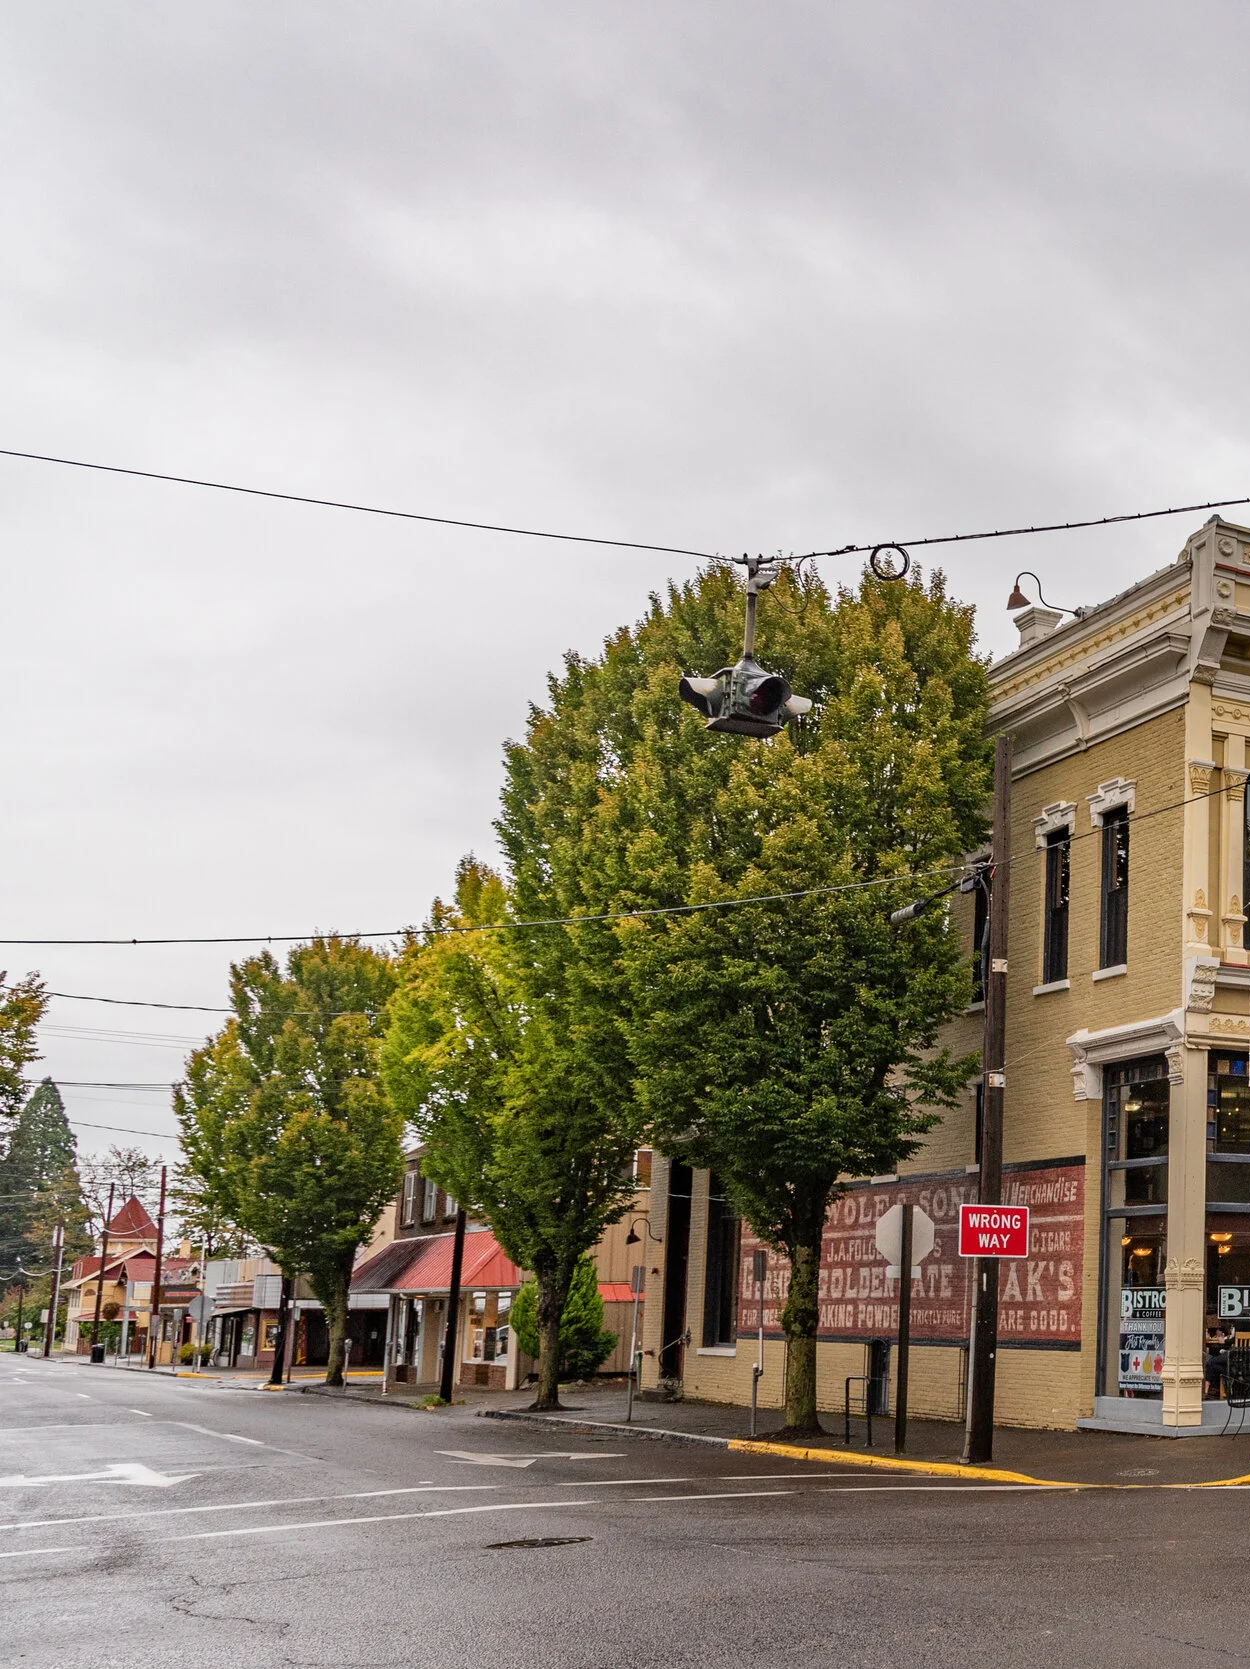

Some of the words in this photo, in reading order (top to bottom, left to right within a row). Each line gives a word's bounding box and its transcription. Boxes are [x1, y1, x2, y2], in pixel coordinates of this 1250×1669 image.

[968, 1213, 1021, 1230] WRONG
[978, 1234, 1011, 1249] WAY
[1121, 1289, 1166, 1318] BISTRO
[820, 1305, 853, 1329] AKING
[858, 1304, 899, 1329] POWDE
[999, 1310, 1024, 1331] ARE
[1141, 1310, 1162, 1318] COFFEE
[1123, 1321, 1148, 1333] THANK
[1148, 1321, 1162, 1333] YOU
[1128, 1374, 1151, 1382] APPRECIATE
